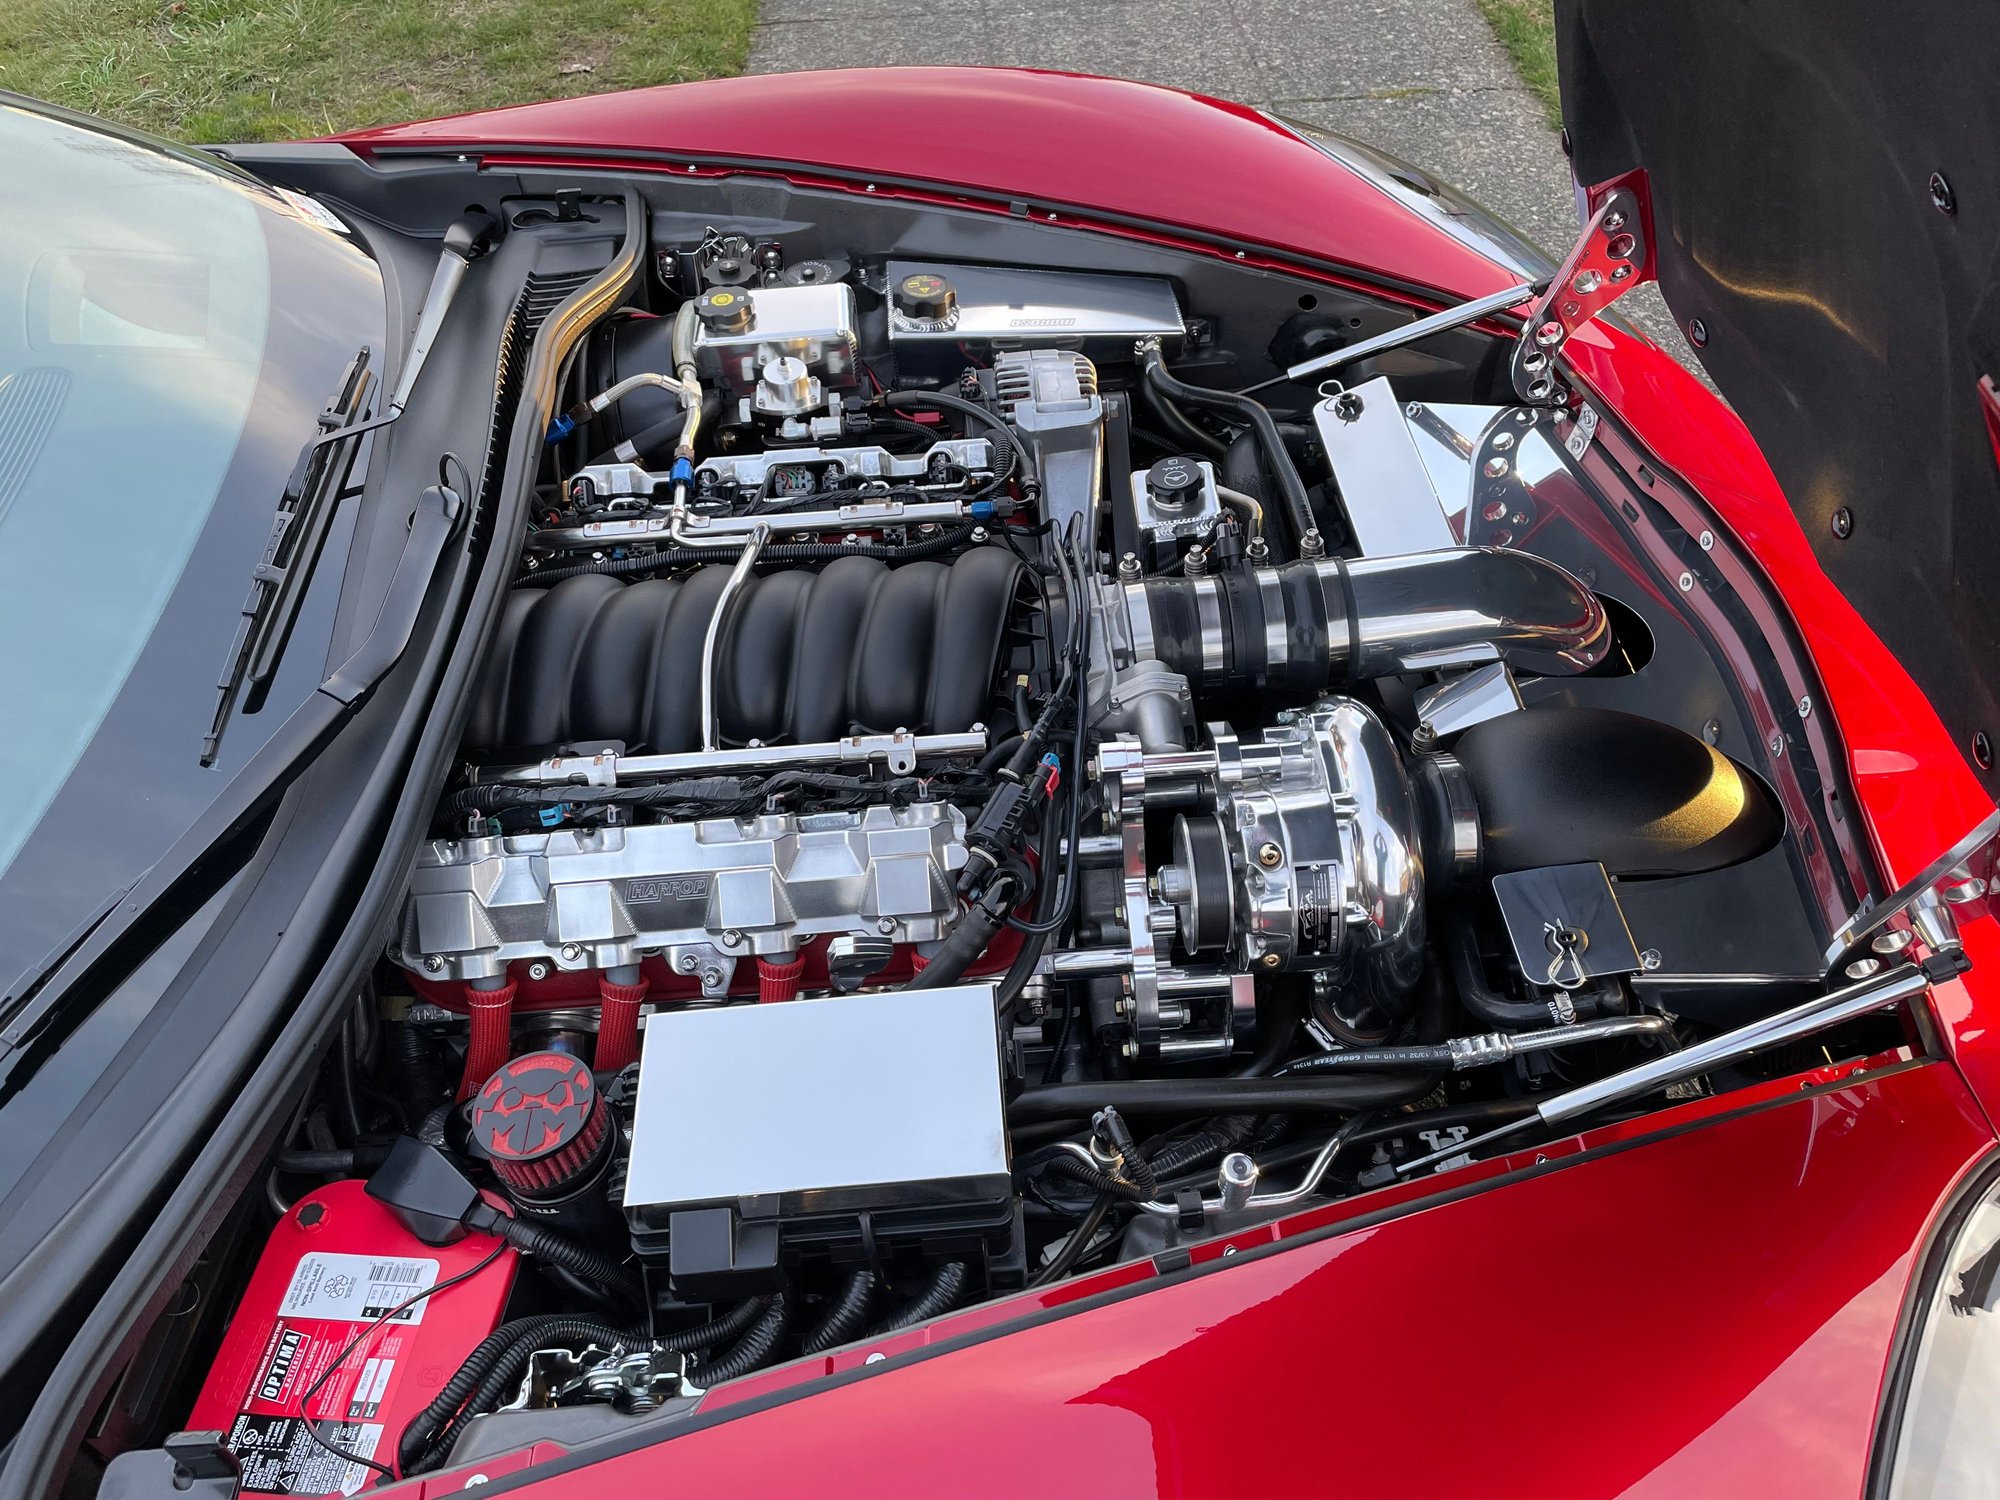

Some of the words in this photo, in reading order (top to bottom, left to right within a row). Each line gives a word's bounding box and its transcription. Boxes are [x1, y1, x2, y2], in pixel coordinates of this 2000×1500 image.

[630, 879, 705, 898] HARROP
[1313, 1052, 1361, 1066] GOODYEAR
[1408, 1049, 1429, 1059] 13/32
[1433, 1049, 1450, 1057] OSE
[300, 1263, 322, 1306] NON-SPILLABLE
[270, 1319, 284, 1343] BATTERY
[262, 1334, 300, 1397] OPTIMA
[284, 1347, 304, 1387] BATTERIES
[255, 1434, 264, 1445] NO
[263, 1421, 276, 1442] SPARKS
[270, 1421, 283, 1443] FLAMES
[276, 1418, 291, 1443] SMOKING
[340, 1427, 348, 1435] DO
[246, 1453, 264, 1487] EXPLOSIVE
